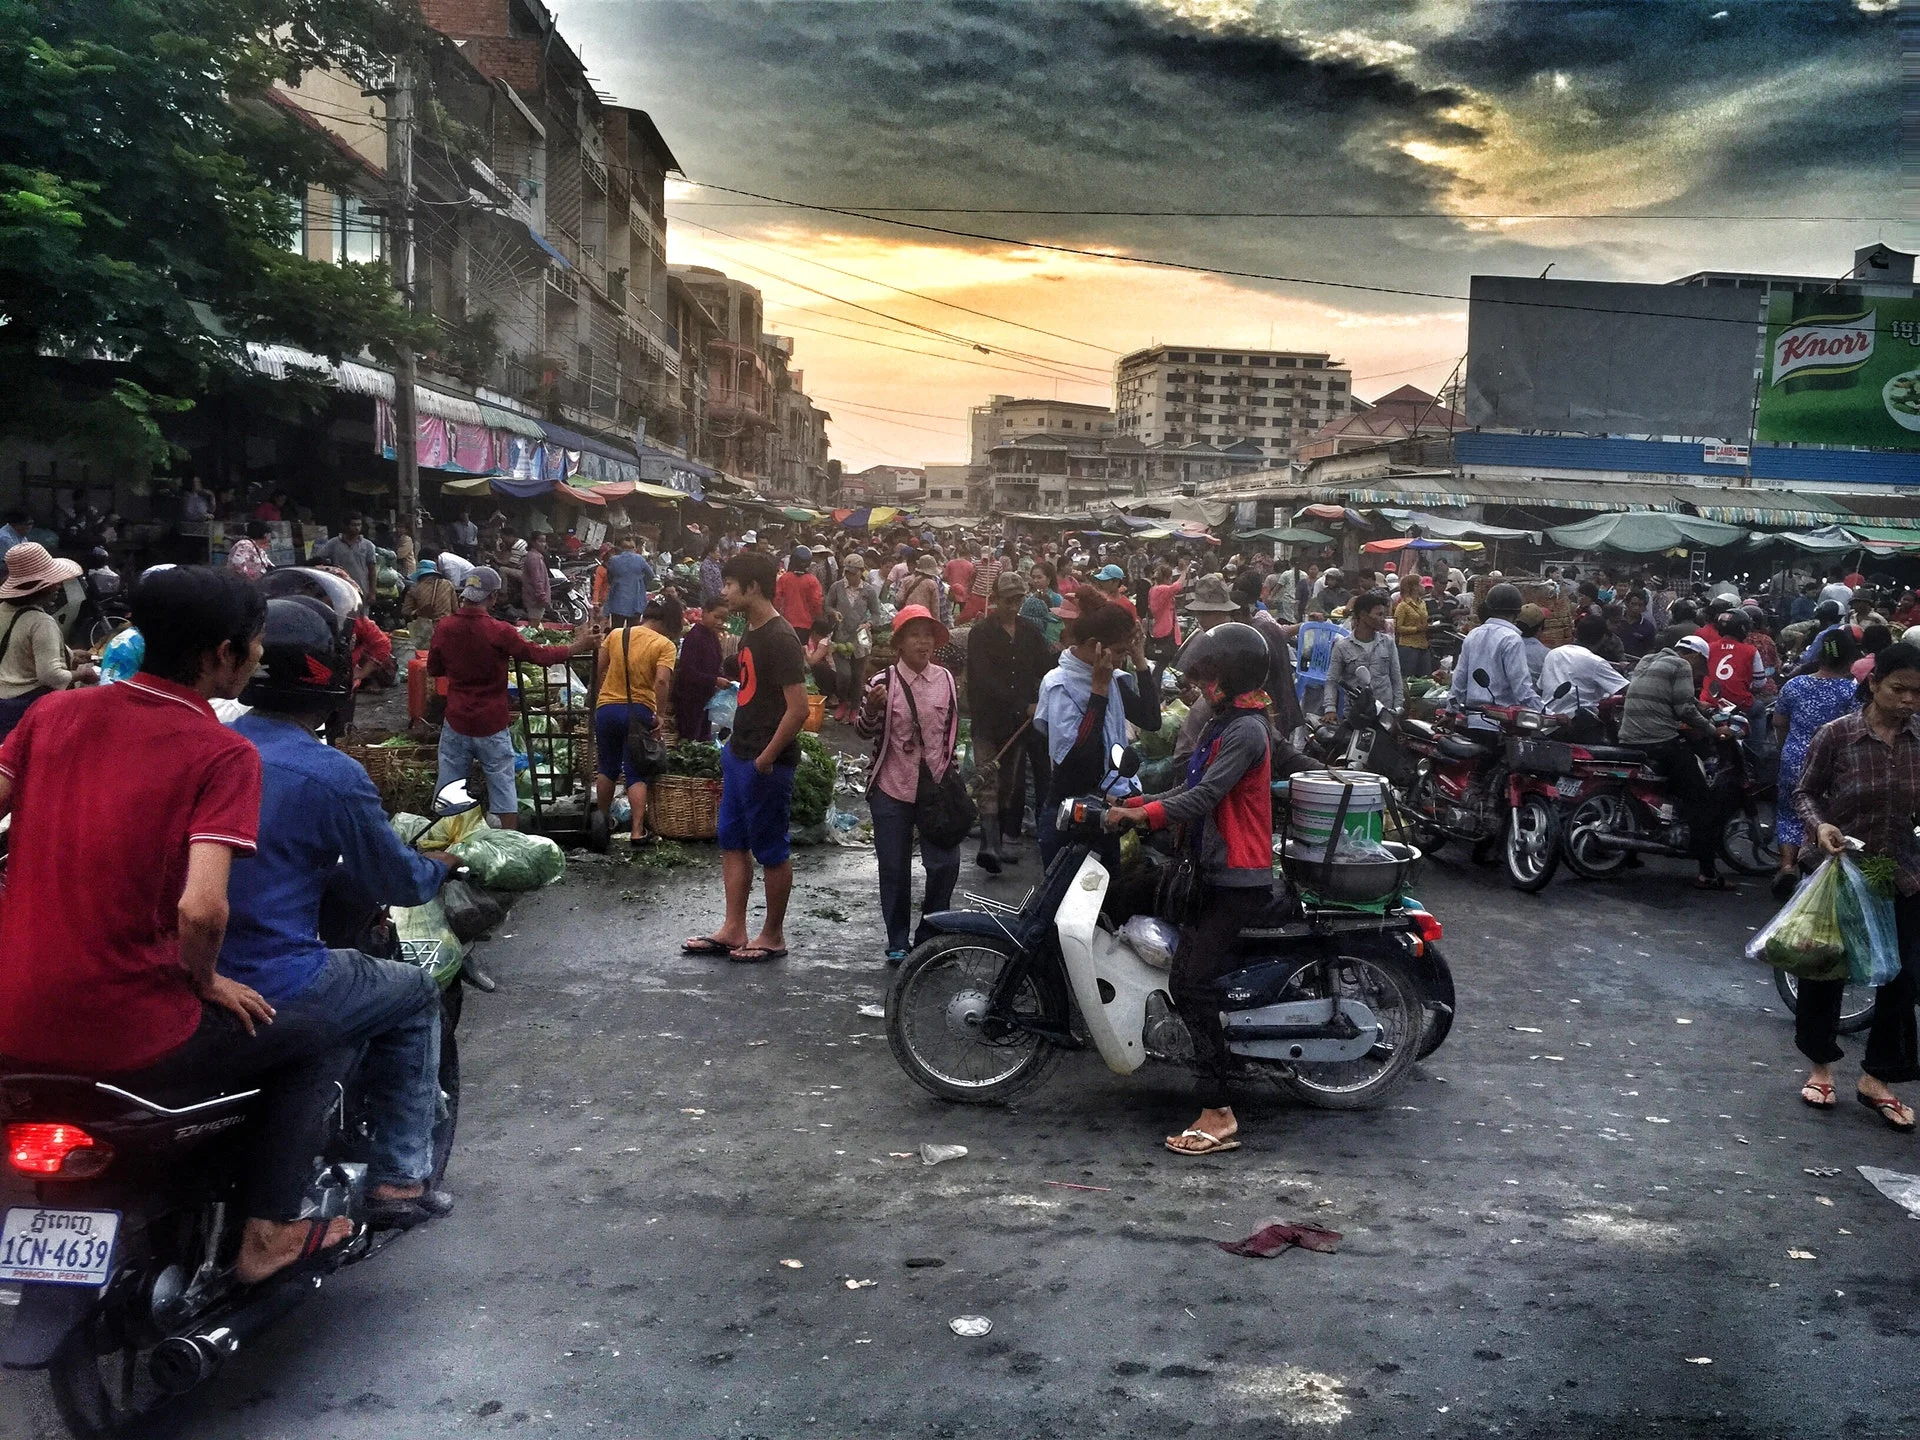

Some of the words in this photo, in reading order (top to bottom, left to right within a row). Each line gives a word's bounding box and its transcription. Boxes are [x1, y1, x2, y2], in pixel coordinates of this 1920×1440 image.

[1778, 331, 1870, 366] Knorr
[1715, 654, 1734, 680] 6
[1, 1236, 108, 1269] 1CN-4639
[13, 1269, 54, 1279] PHNOM
[57, 1271, 89, 1281] PENH
